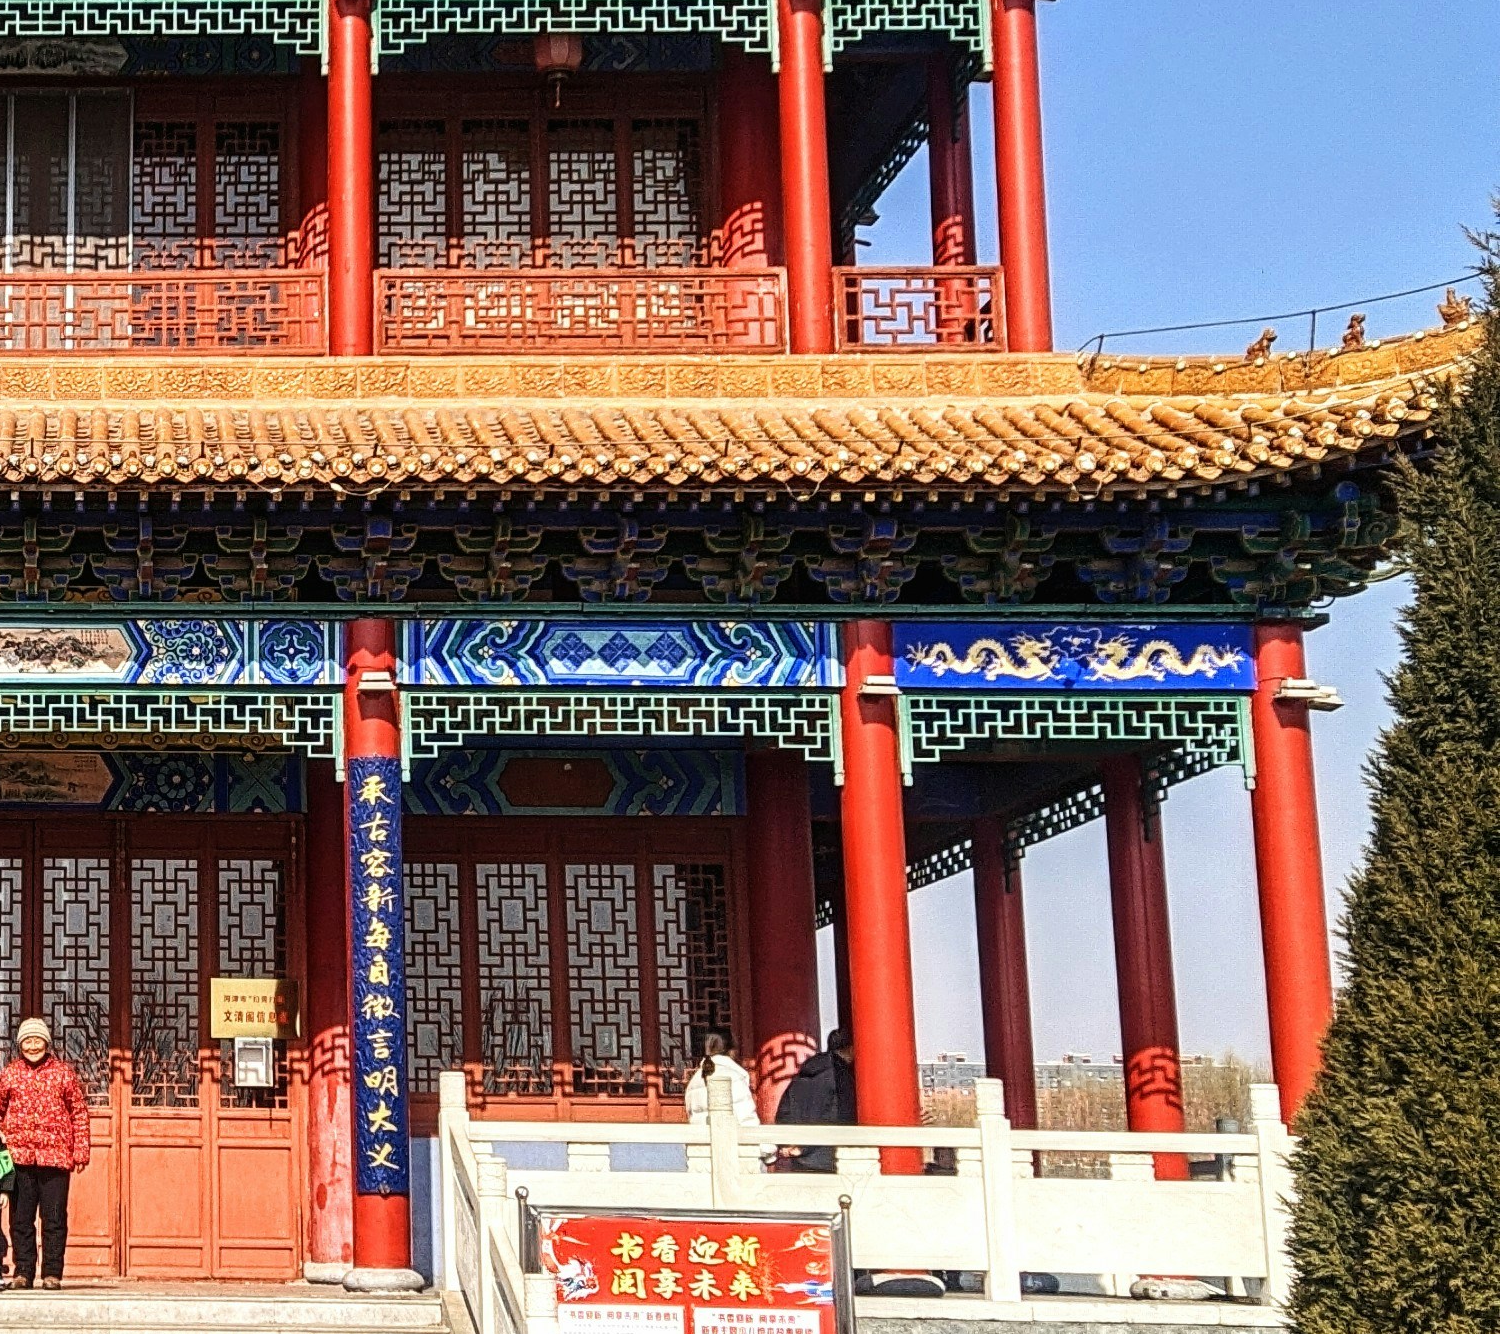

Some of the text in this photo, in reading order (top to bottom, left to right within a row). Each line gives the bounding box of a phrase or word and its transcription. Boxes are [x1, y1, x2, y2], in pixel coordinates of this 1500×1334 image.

[610, 1232, 760, 1267] 书香迎新
[610, 1267, 761, 1301] 阅享未来
